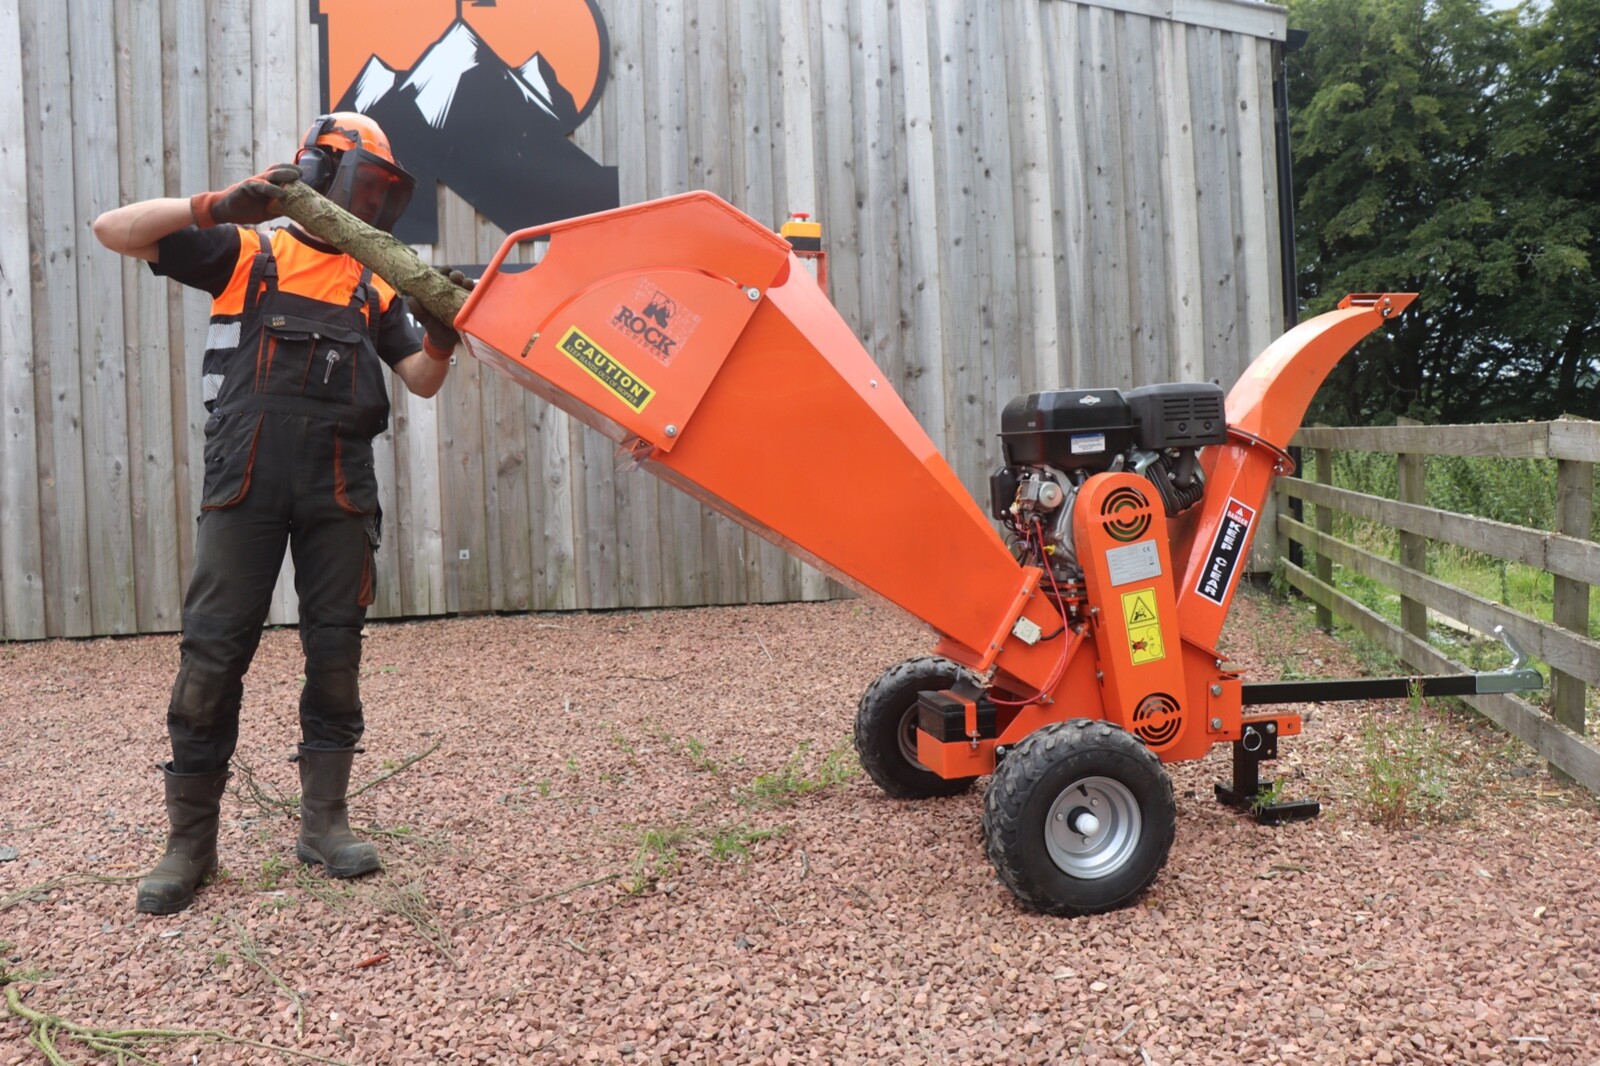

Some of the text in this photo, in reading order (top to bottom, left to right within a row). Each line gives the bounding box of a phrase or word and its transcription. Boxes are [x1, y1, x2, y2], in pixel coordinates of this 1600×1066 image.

[610, 320, 669, 362] MACHINERY
[614, 305, 677, 357] ROCK
[565, 345, 582, 358] KEEP
[579, 354, 599, 374] HANDS
[598, 369, 611, 382] OUT
[617, 385, 638, 405] HOPPER
[574, 338, 644, 397] CAUTION
[1204, 520, 1241, 597] KEEP CLEAR
